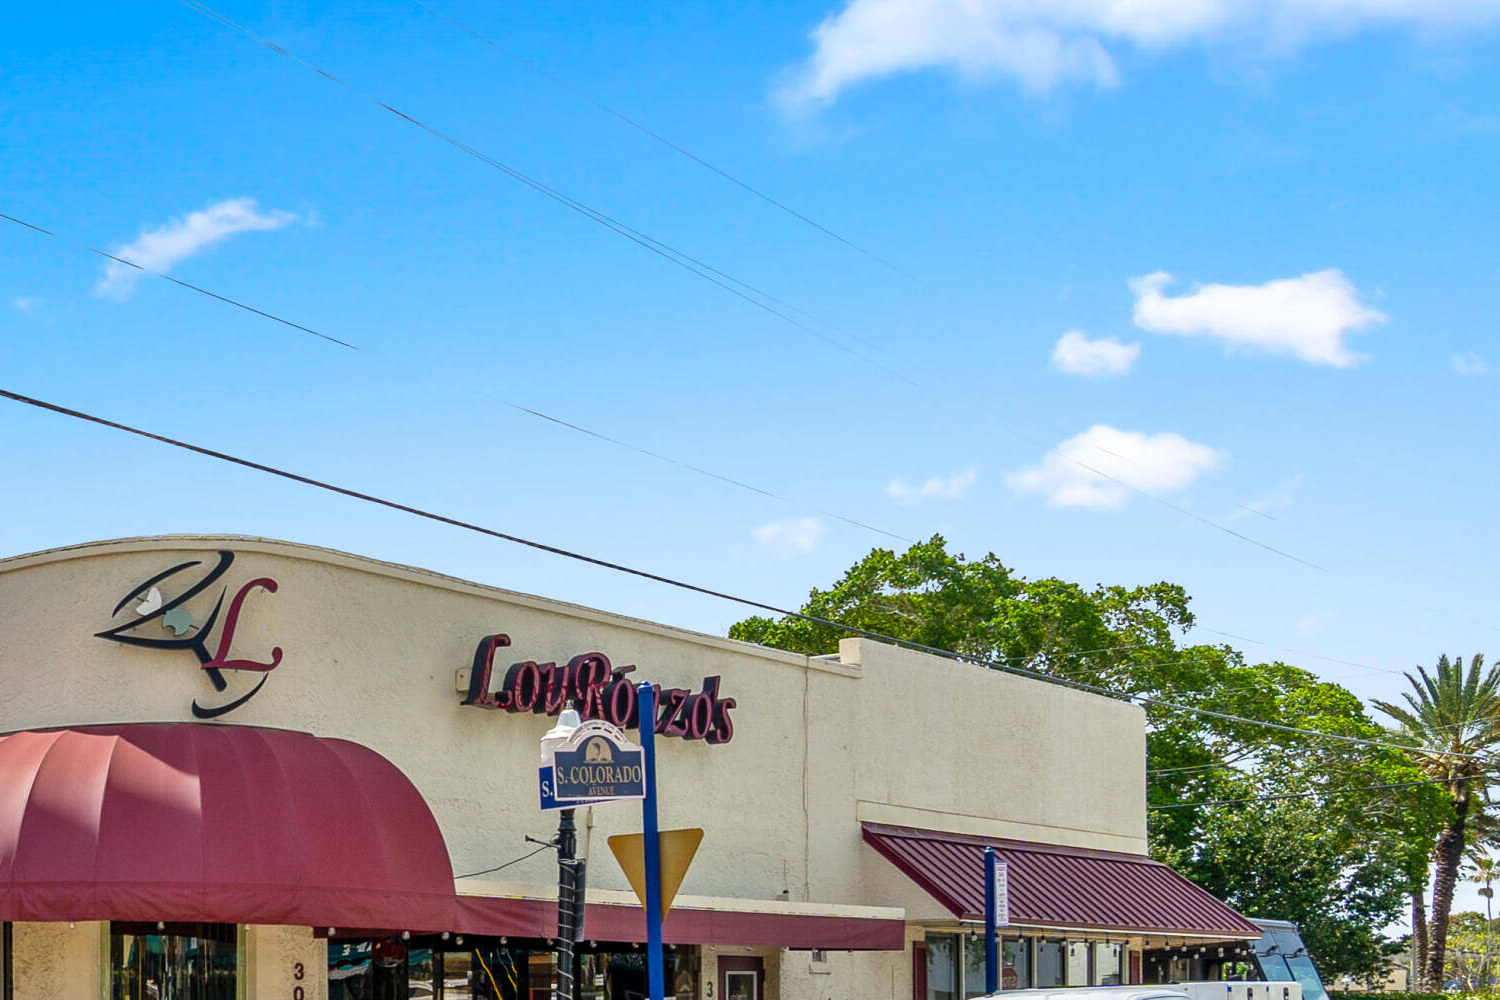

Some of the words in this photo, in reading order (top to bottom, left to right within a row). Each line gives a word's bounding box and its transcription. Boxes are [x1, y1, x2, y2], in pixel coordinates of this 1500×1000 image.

[557, 766, 568, 784] S.
[570, 765, 641, 784] COLORADO
[588, 786, 615, 796] AVENUE
